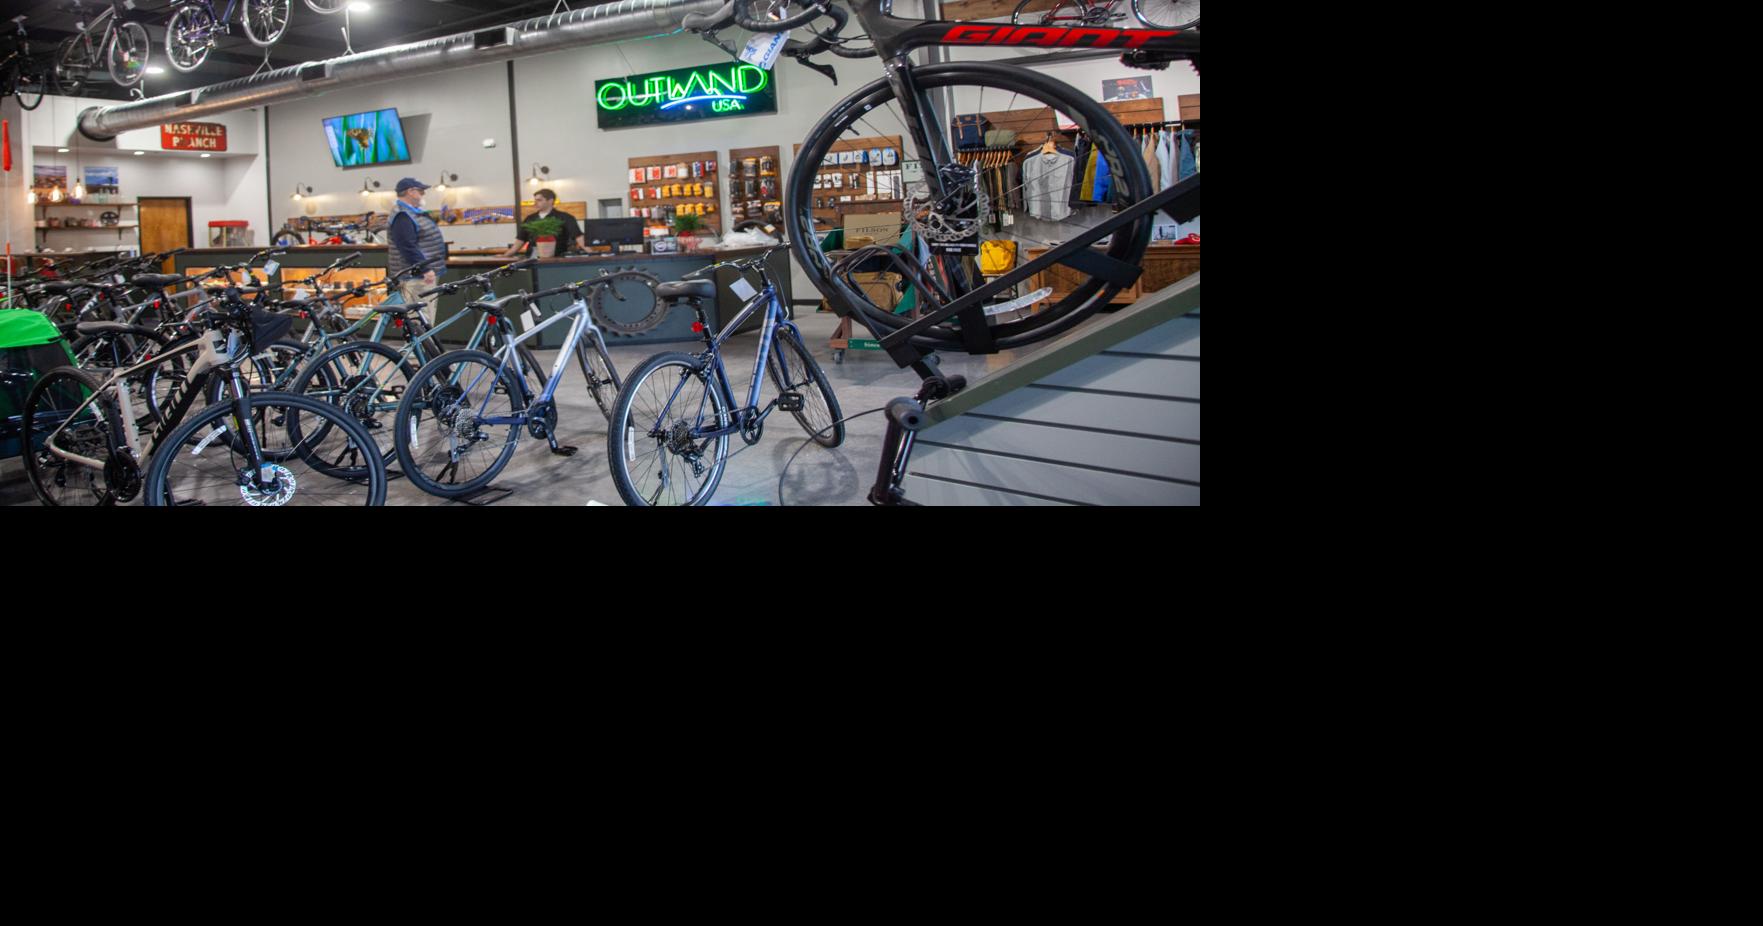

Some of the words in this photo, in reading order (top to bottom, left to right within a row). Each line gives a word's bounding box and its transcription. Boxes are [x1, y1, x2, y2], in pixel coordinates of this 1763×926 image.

[941, 26, 1180, 48] GIANT
[763, 31, 784, 61] GIAN
[597, 65, 768, 111] OUTLAND
[712, 99, 742, 112] USA
[164, 123, 223, 136] NASILE
[172, 136, 217, 148] ANCH
